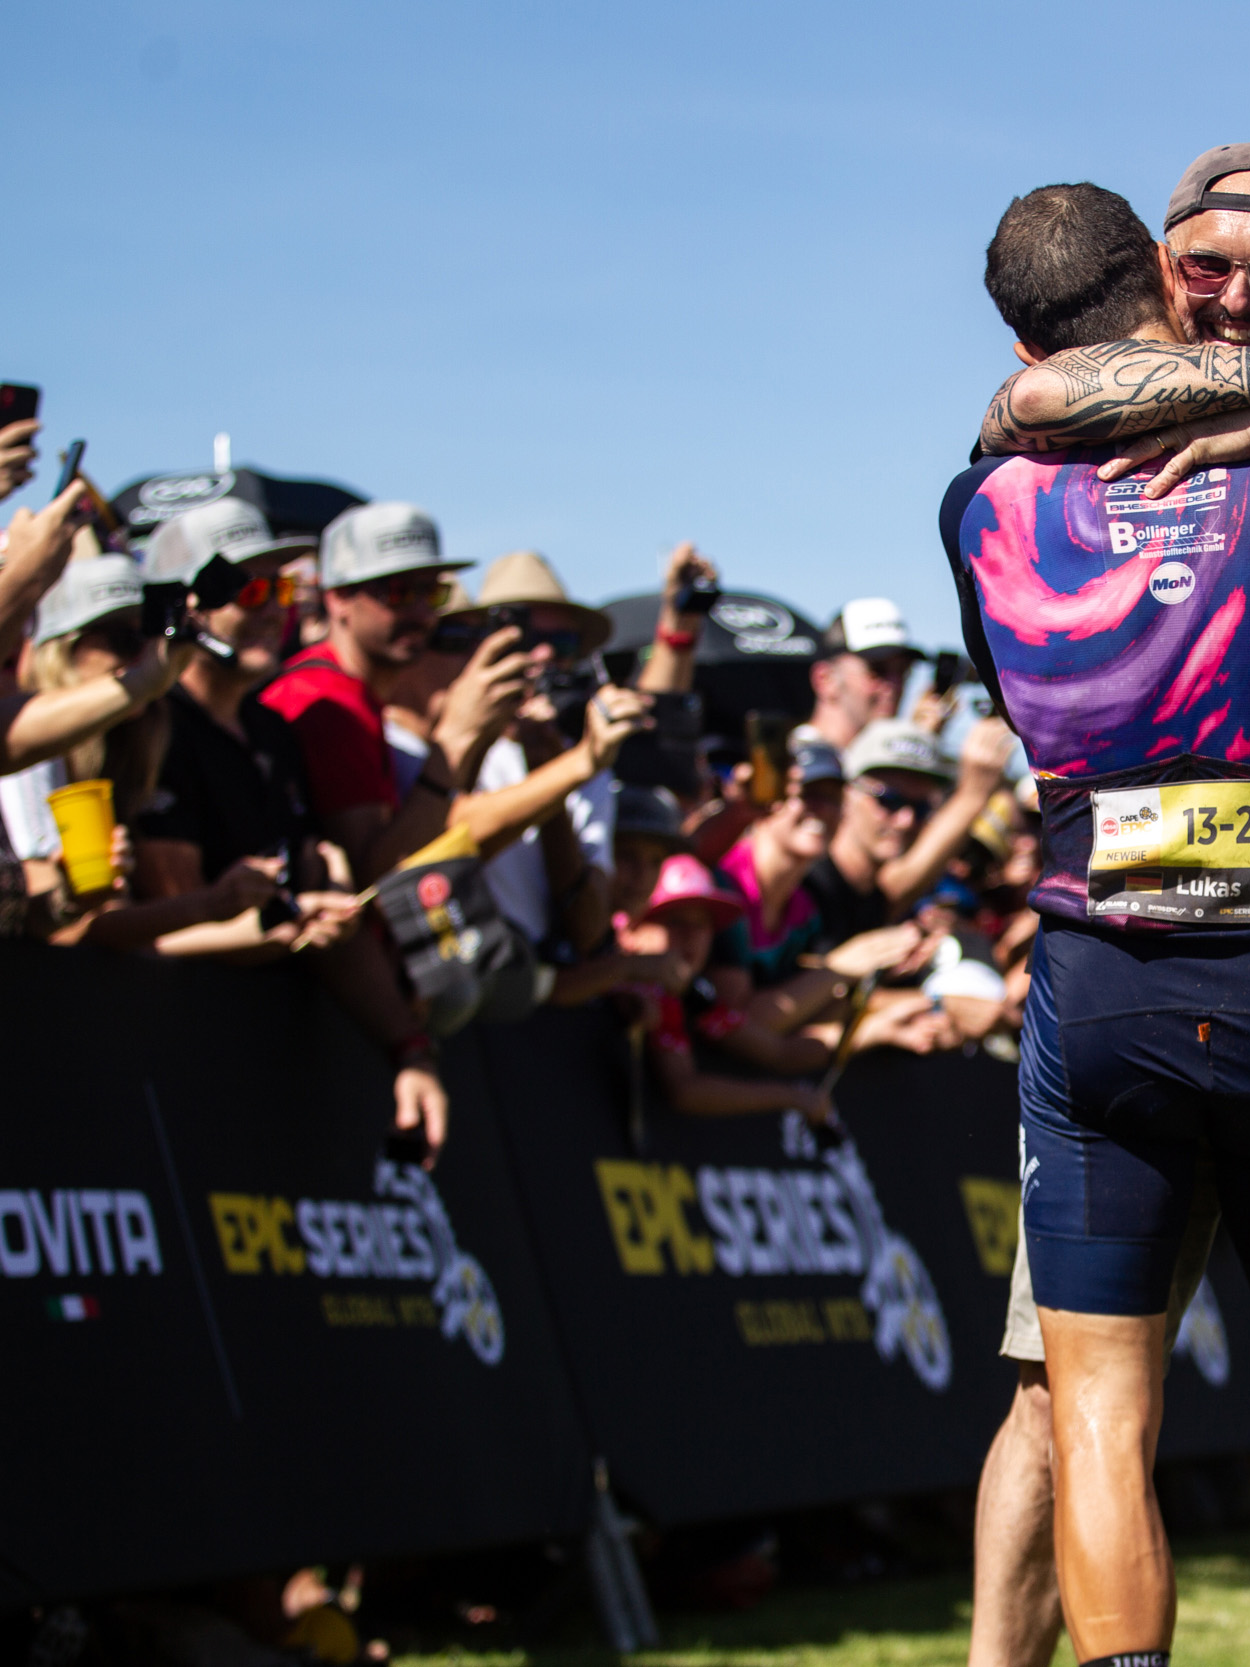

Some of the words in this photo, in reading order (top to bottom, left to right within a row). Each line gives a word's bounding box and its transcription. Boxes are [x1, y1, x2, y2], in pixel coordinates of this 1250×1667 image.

[1109, 490, 1222, 511] BIKESCHMIEDE.EU
[1108, 521, 1197, 554] Bollinger
[1138, 547, 1203, 559] Kunststofftechnik
[1203, 542, 1225, 552] GmbH
[1152, 575, 1192, 592] MoN
[1119, 814, 1139, 823] CAPE
[1120, 820, 1152, 836] EPIC
[1106, 850, 1147, 862] NEWBIE
[1176, 874, 1241, 898] Lukas
[594, 1158, 714, 1276] EPIC
[697, 1165, 868, 1276] SERIES
[209, 1191, 305, 1274] EPIC
[297, 1199, 436, 1279] SERIES
